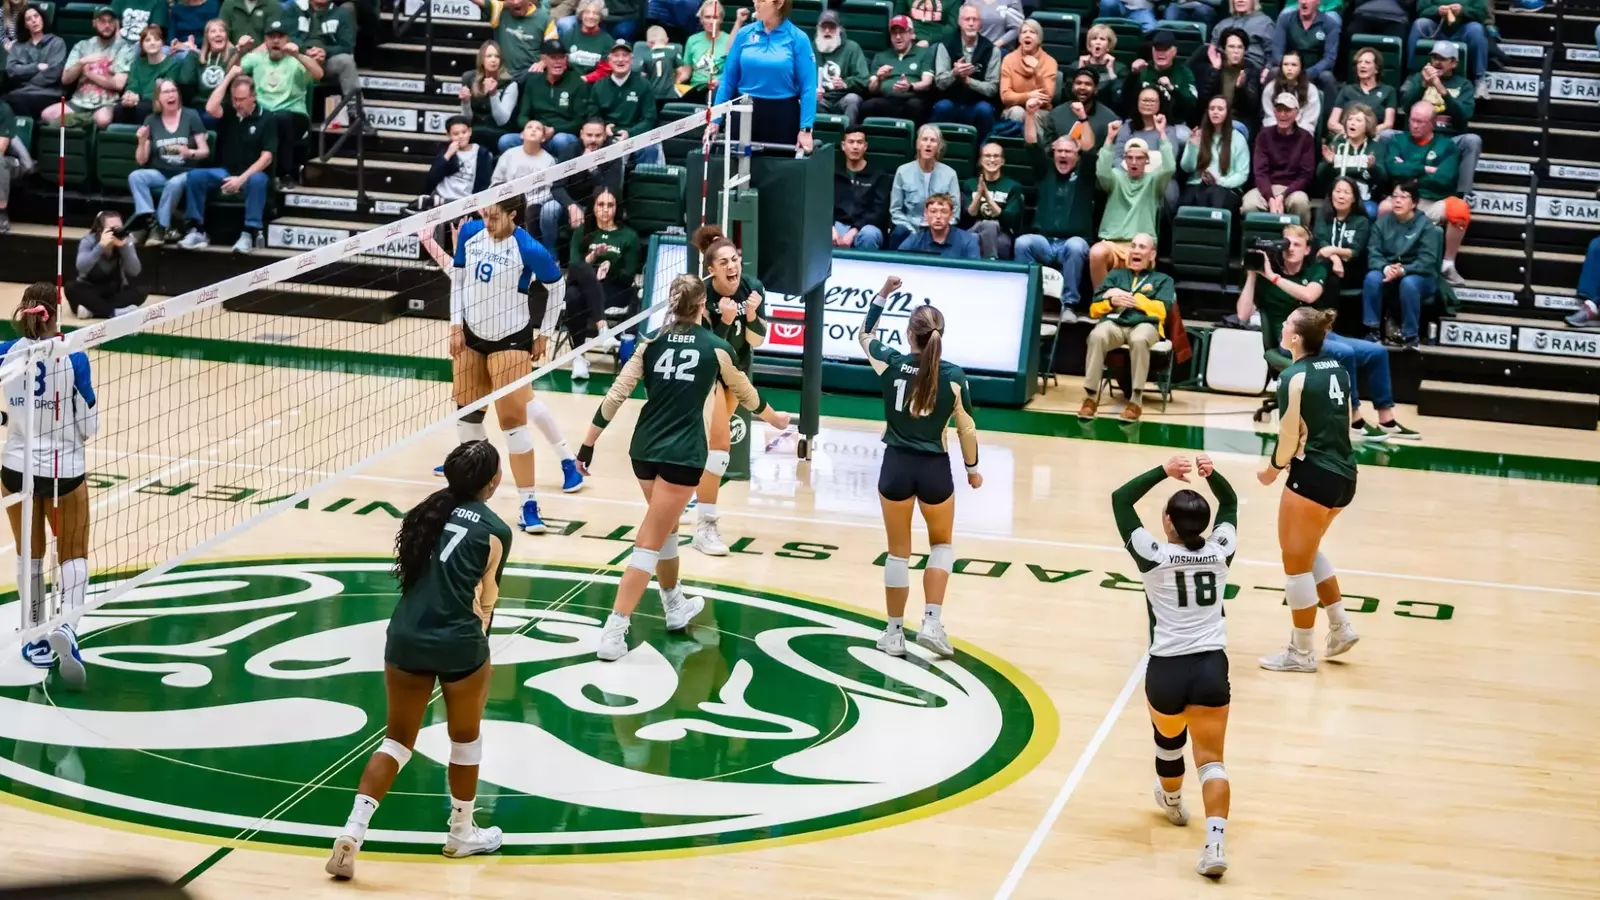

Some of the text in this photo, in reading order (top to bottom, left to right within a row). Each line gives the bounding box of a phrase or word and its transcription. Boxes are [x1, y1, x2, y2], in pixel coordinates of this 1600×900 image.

[433, 3, 470, 15] RAMS
[1495, 79, 1536, 92] RAMS
[1576, 85, 1600, 97] RA
[367, 113, 406, 126] RAMS
[1481, 199, 1524, 212] RAMS
[1565, 205, 1600, 219] RAM
[297, 234, 337, 246] RAMS
[475, 260, 493, 283] 19
[667, 334, 696, 343] LEBER
[823, 323, 902, 345] OYTA
[1462, 330, 1508, 345] RAMS
[1551, 338, 1597, 353] RAMS
[653, 348, 700, 381] 42
[900, 363, 920, 376] POR
[1312, 360, 1340, 370] HERMAN
[1329, 374, 1344, 405] 4
[9, 396, 60, 410] AIR ORC
[451, 507, 481, 523] FORD
[439, 522, 468, 562] 7
[541, 517, 839, 560] STTE
[872, 551, 1454, 620] CORADO
[1175, 571, 1217, 607] 18
